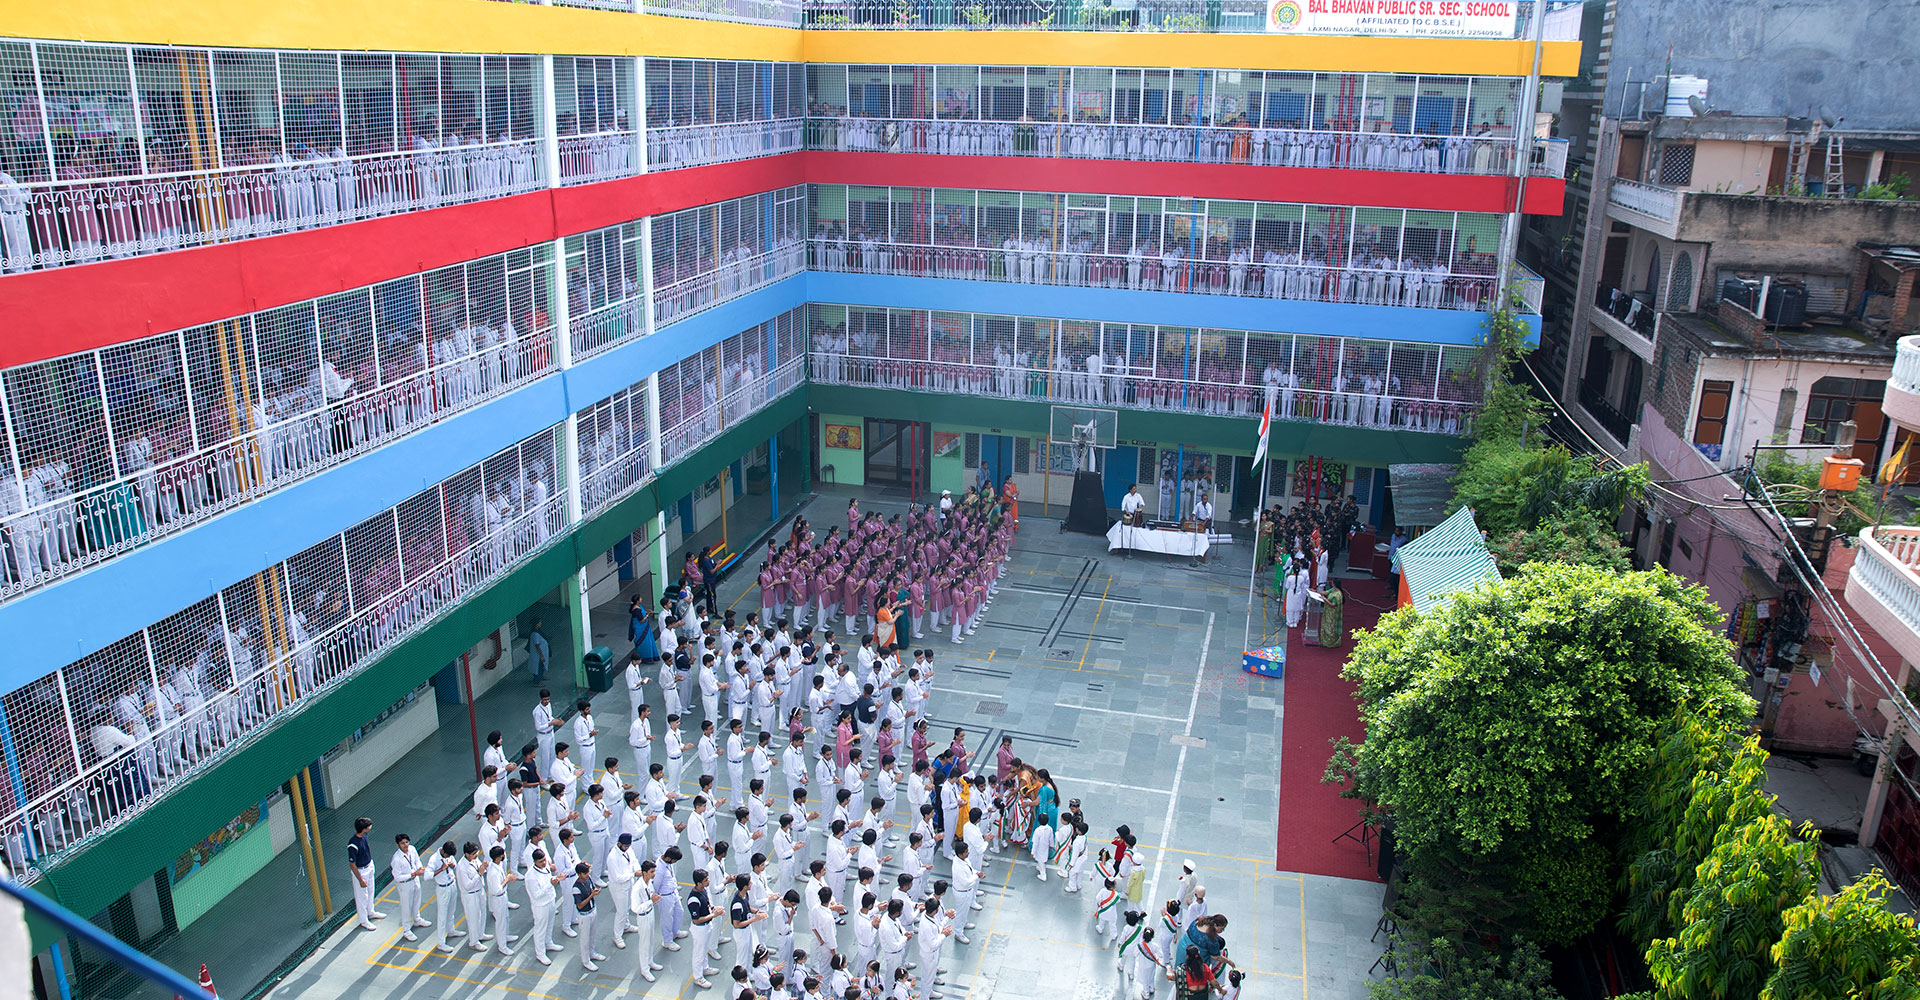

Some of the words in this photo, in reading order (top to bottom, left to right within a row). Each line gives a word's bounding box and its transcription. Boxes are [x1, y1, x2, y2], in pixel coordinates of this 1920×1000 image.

[1308, 0, 1328, 13] BAL
[1332, 0, 1374, 14] BHAVAN
[1377, 1, 1416, 15] PUBLIC
[1419, 1, 1435, 15] SR.
[1439, 2, 1463, 16] SEC.
[1466, 2, 1510, 17] SCHOOL
